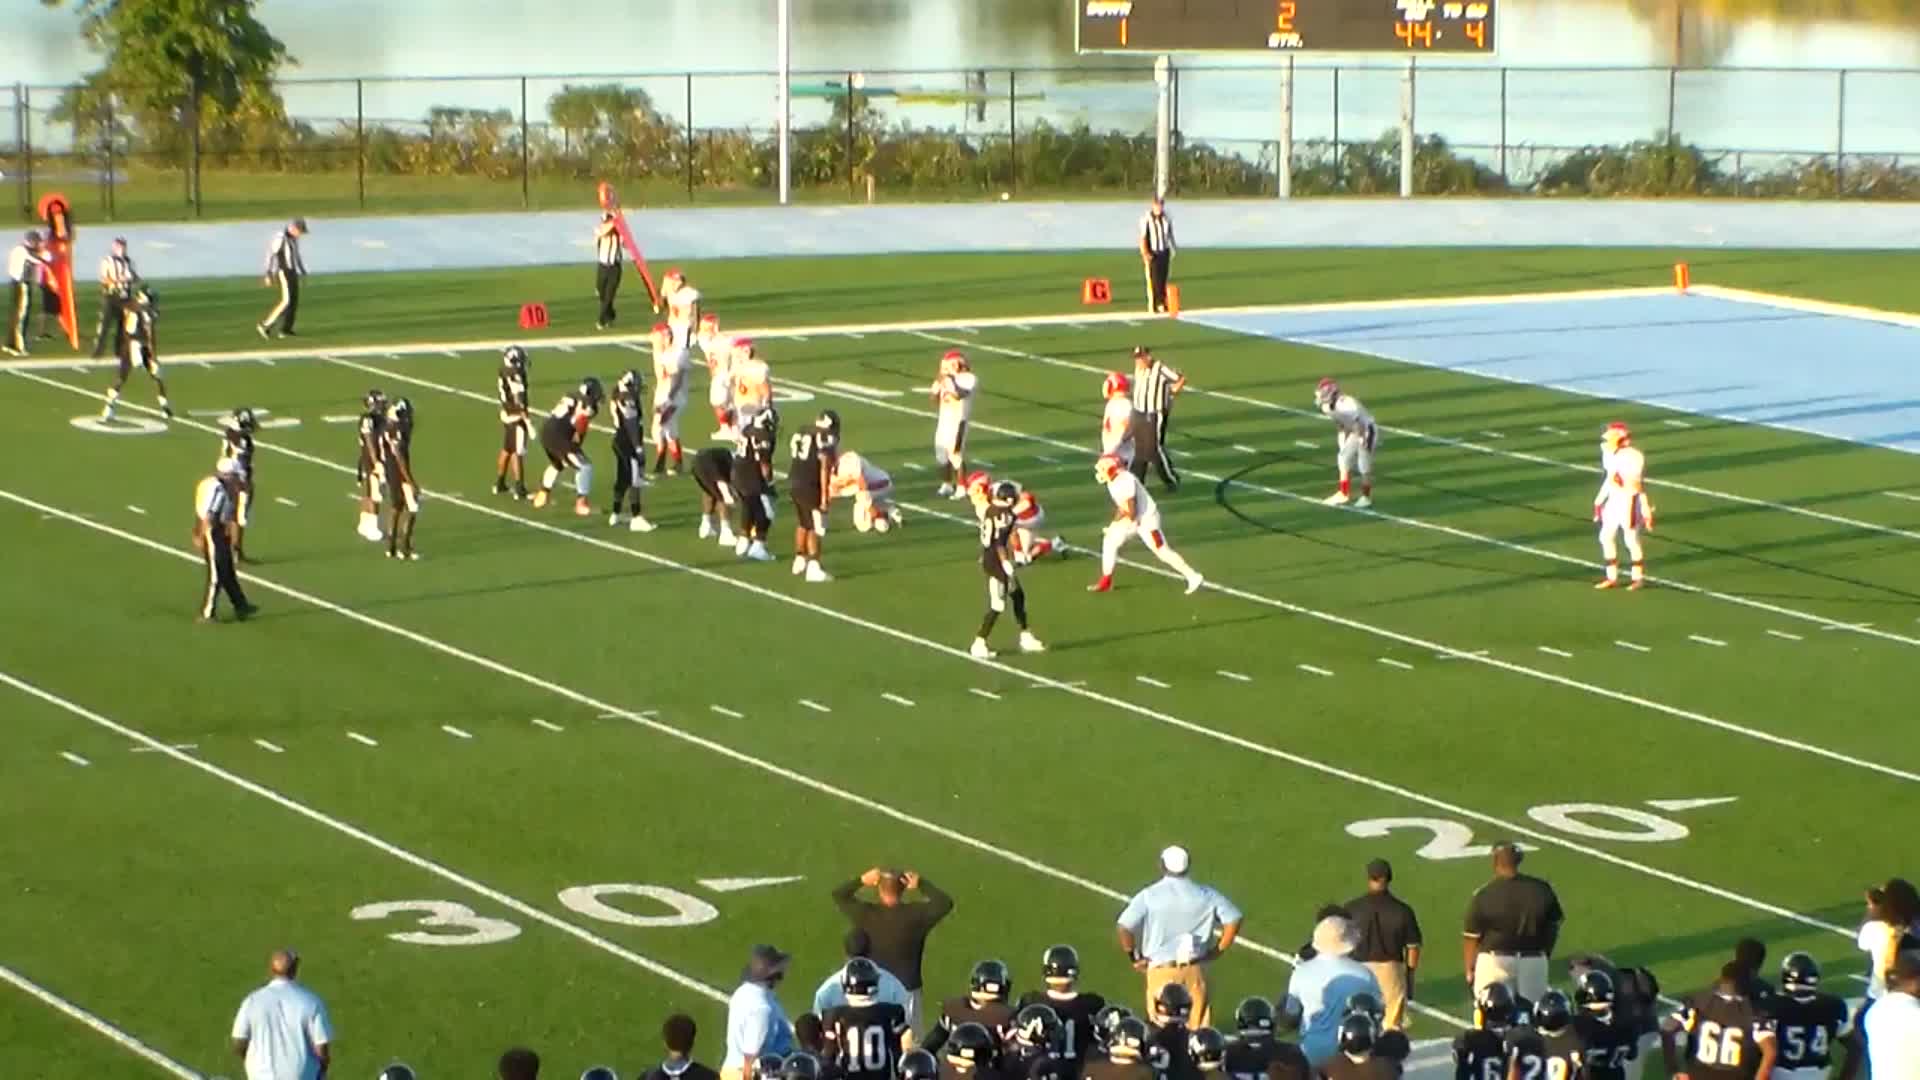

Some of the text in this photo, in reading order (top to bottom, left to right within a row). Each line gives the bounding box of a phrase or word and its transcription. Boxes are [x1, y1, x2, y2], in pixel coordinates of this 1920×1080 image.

[1279, 2, 1295, 29] 2
[1395, 21, 1431, 47] 44
[1465, 21, 1484, 47] 4
[527, 306, 545, 326] 10
[1345, 803, 1691, 860] 20
[350, 883, 720, 946] 30
[846, 1024, 887, 1072] 10
[1696, 1020, 1745, 1066] 66
[1784, 1024, 1829, 1061] 54
